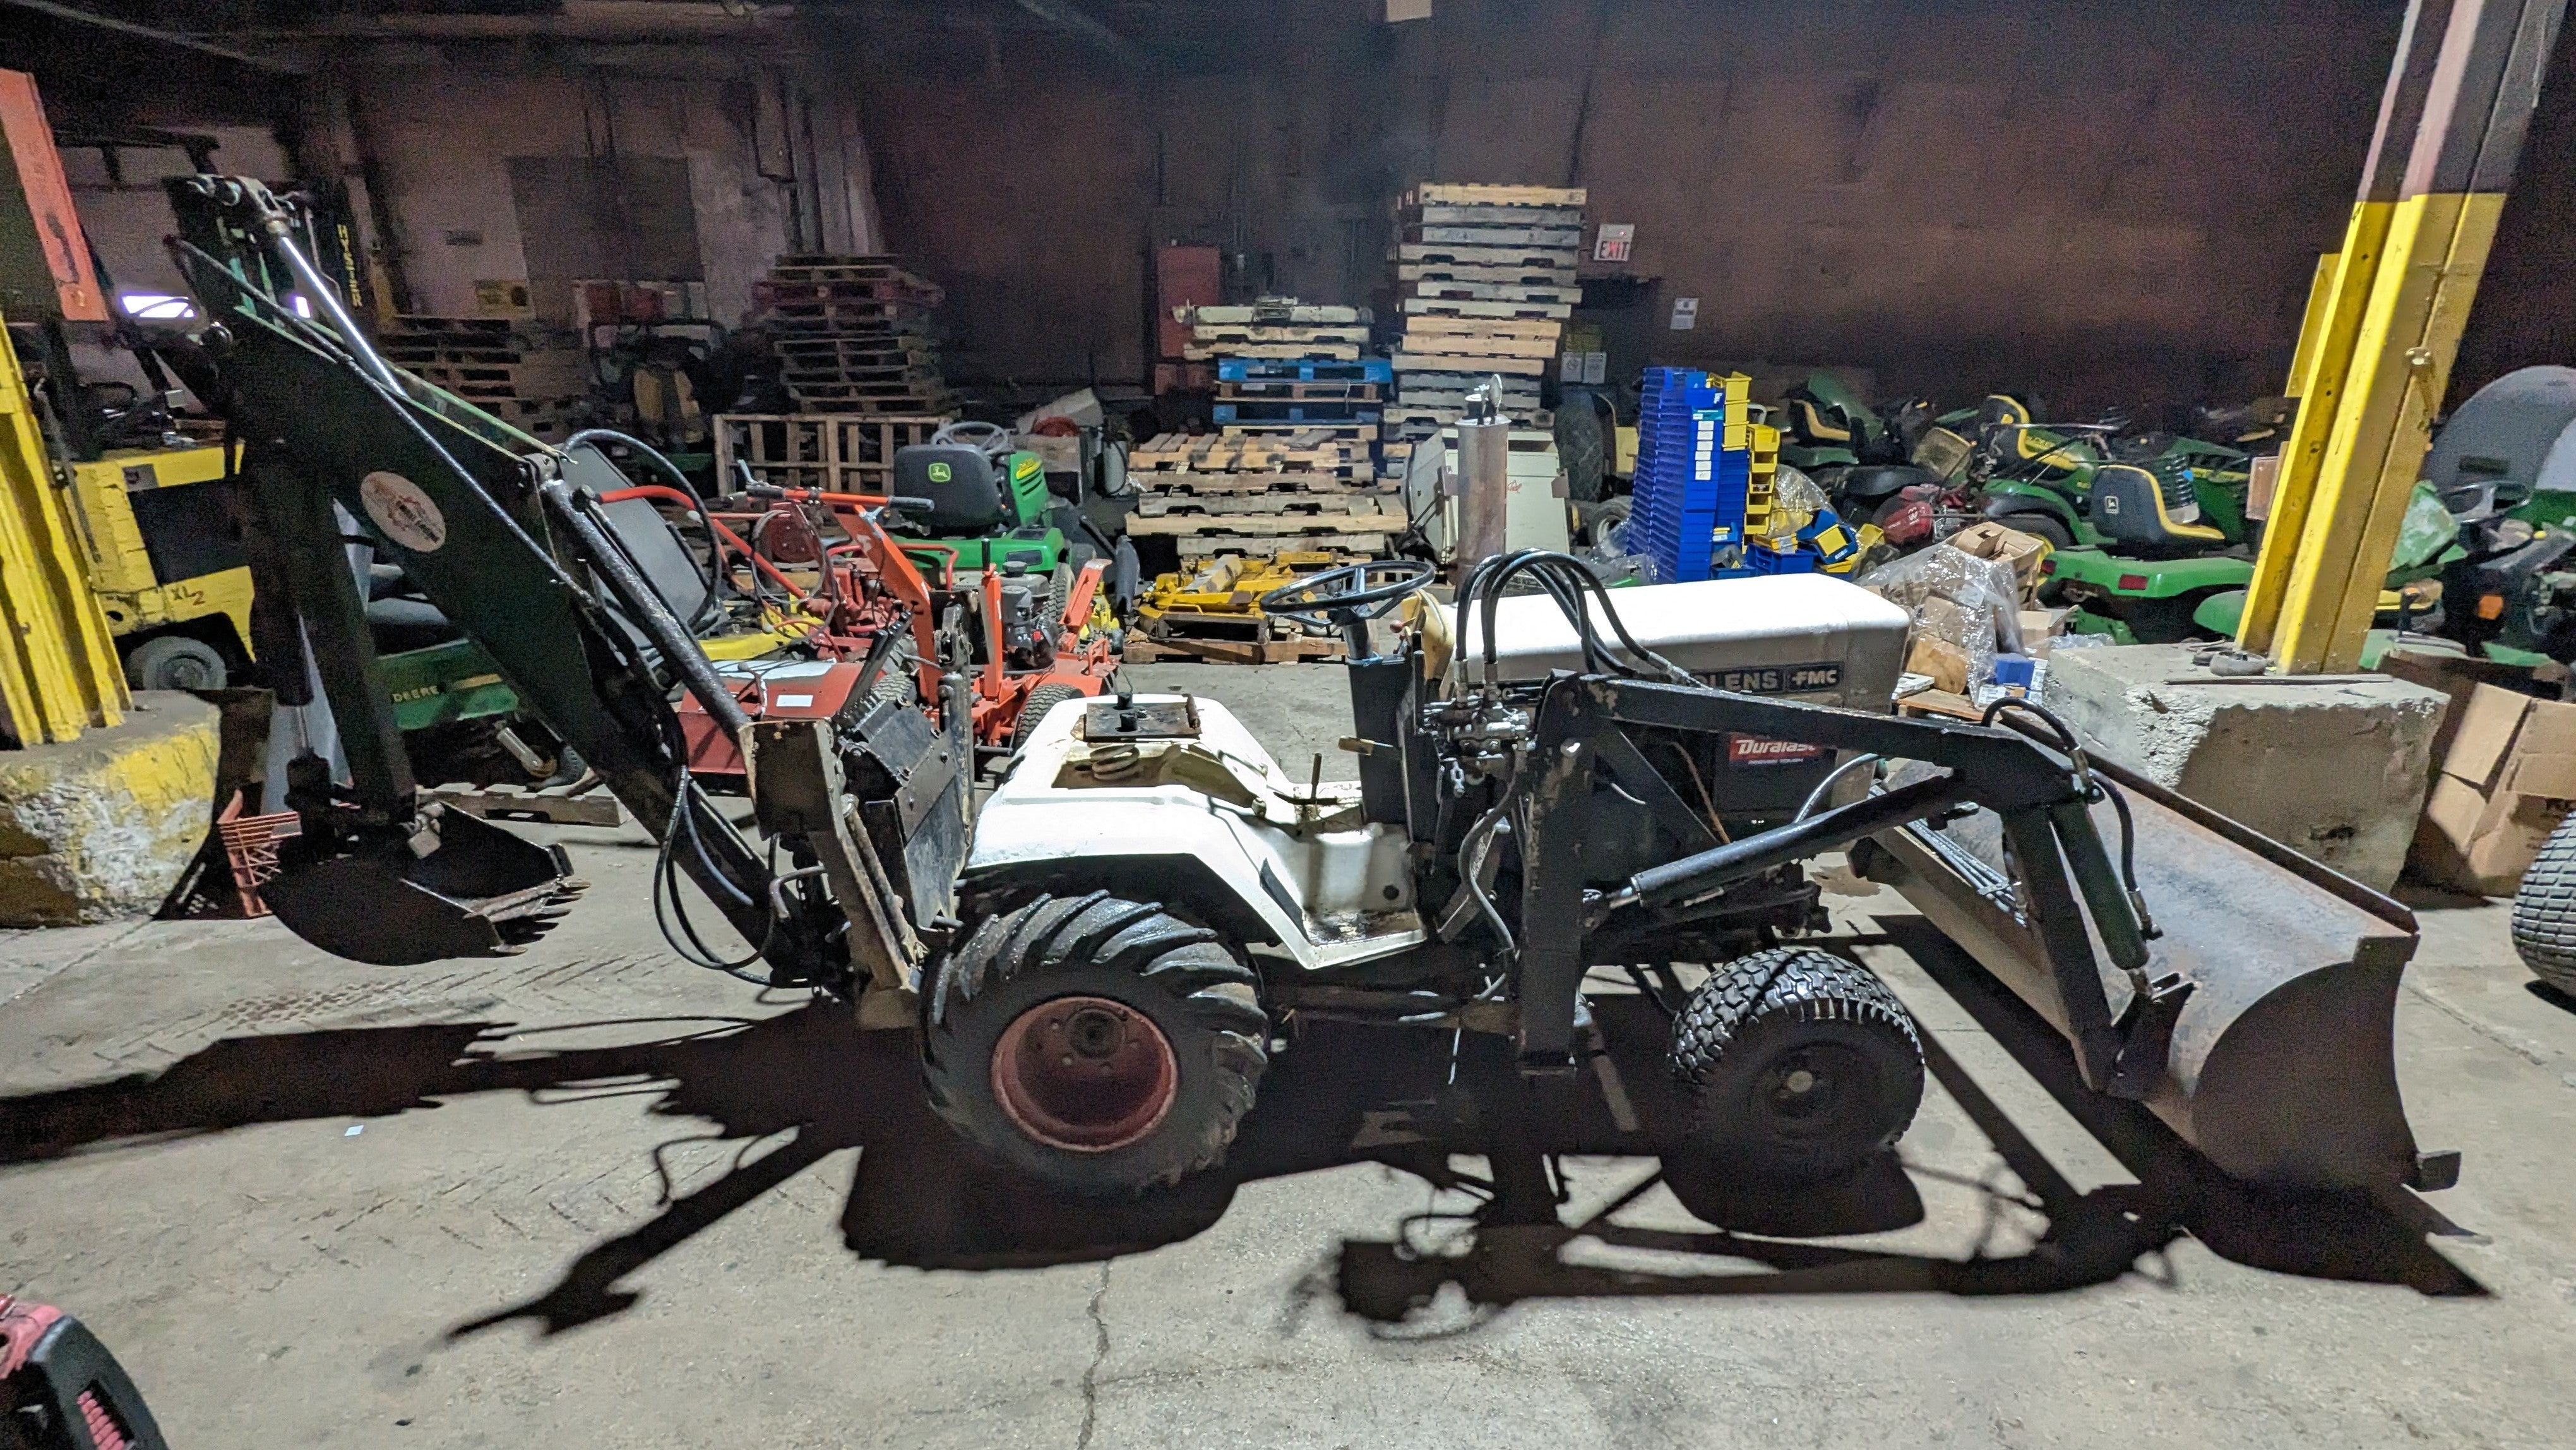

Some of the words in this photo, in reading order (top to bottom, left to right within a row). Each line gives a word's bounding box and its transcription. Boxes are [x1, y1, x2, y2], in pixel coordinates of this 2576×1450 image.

[1599, 240, 1630, 259] EXIT
[337, 224, 363, 307] HYSTER
[1693, 671, 1778, 691] LENS
[1792, 669, 1837, 686] FMC
[392, 685, 439, 702] DEERE
